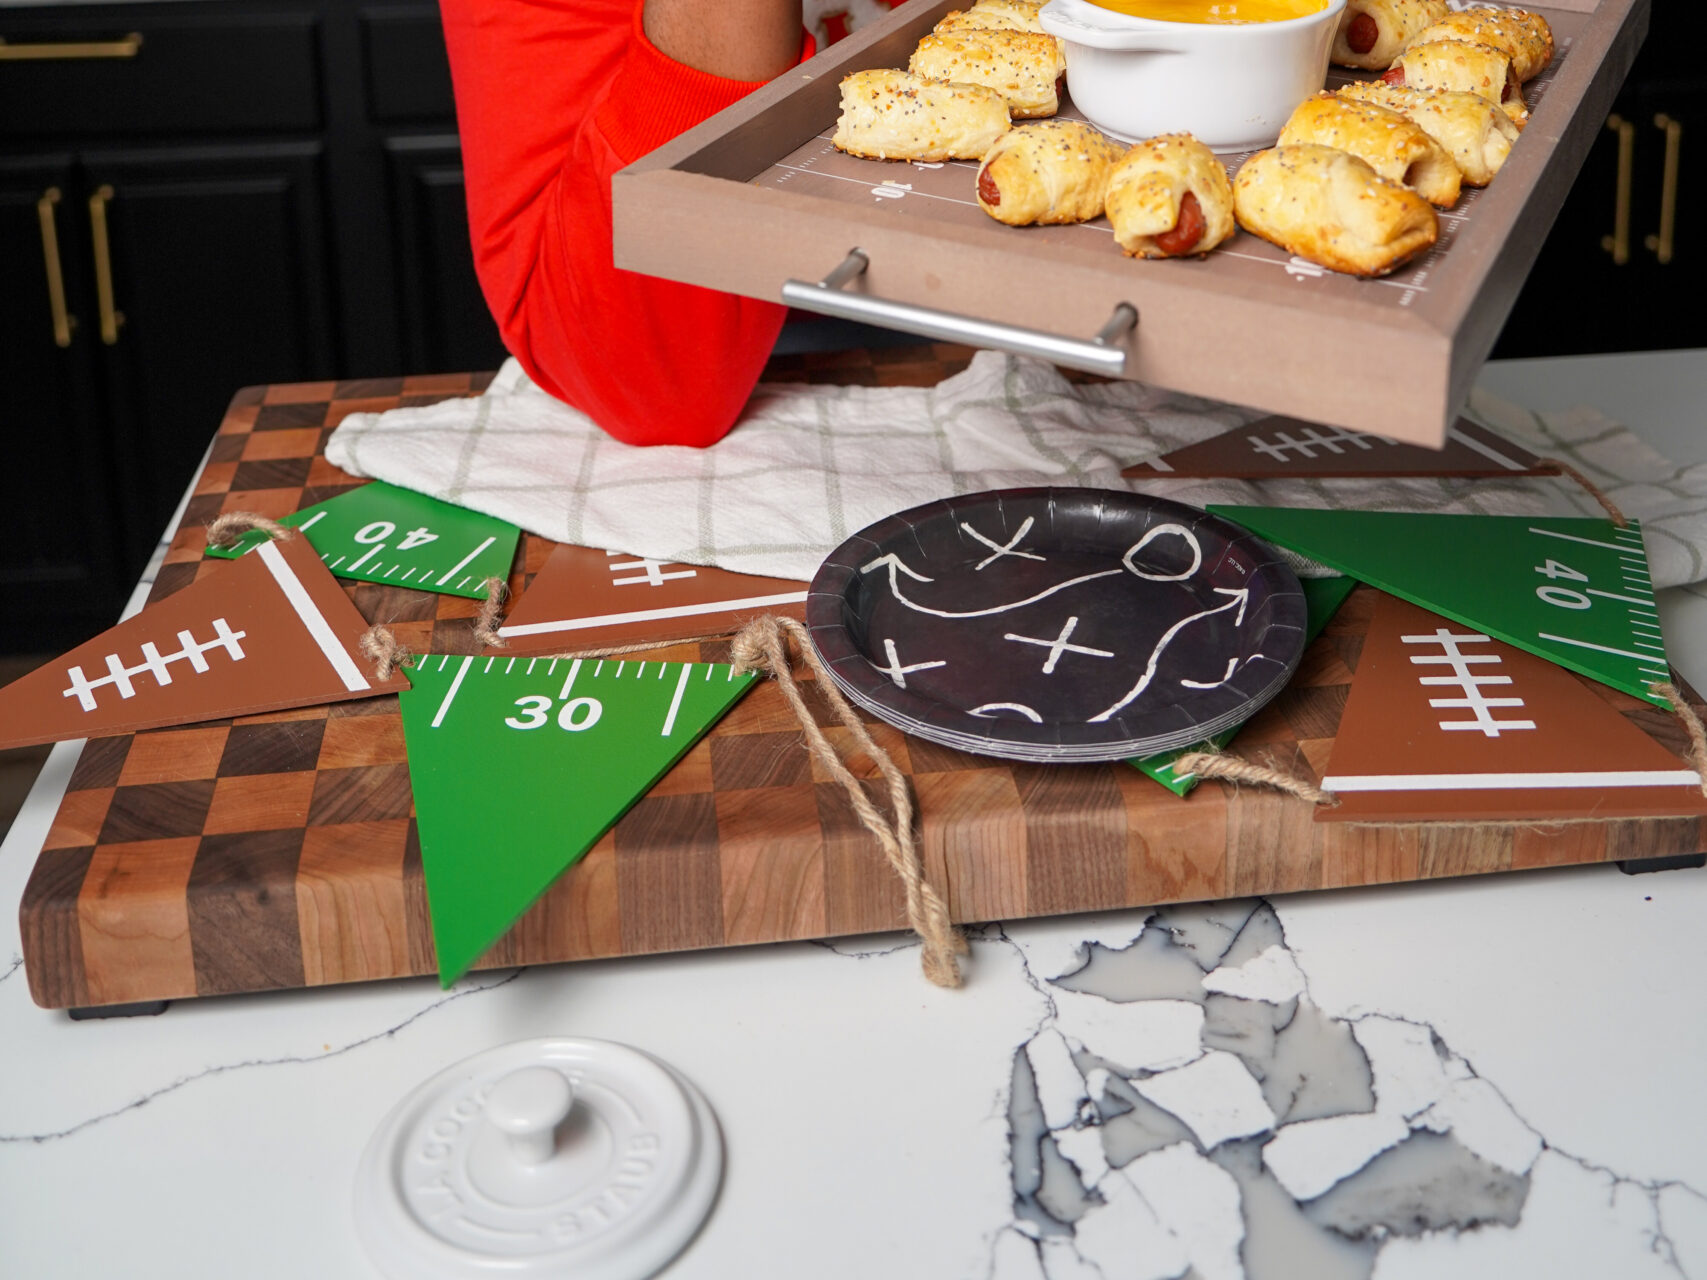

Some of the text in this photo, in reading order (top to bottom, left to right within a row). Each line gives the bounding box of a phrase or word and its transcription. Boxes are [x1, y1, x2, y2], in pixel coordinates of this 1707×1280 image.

[354, 521, 439, 552] 40
[1535, 558, 1590, 610] 40
[505, 695, 602, 732] 30
[549, 1132, 661, 1245] STAUB
